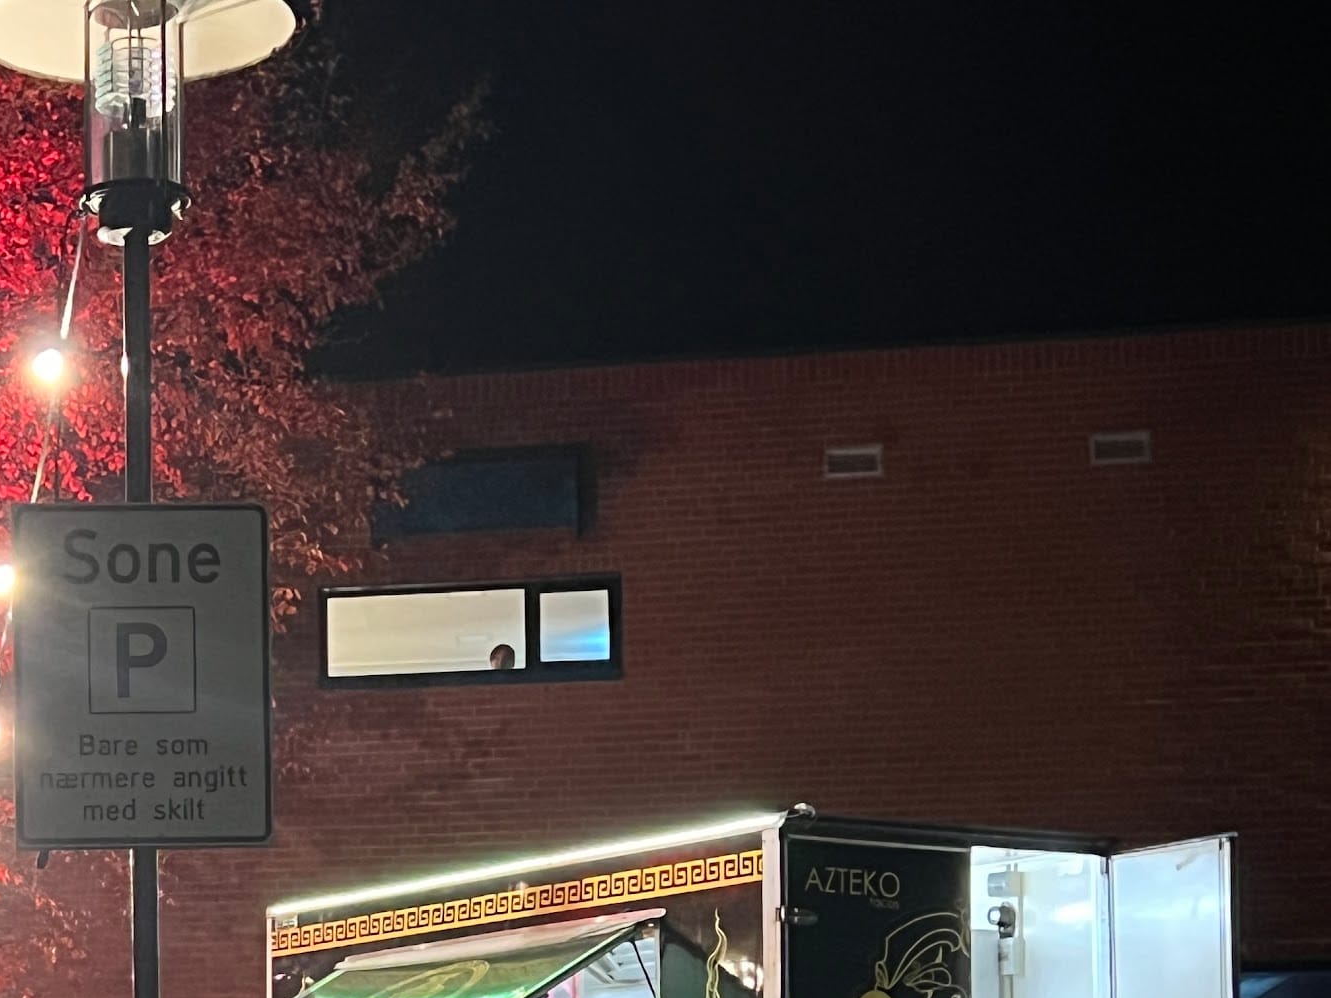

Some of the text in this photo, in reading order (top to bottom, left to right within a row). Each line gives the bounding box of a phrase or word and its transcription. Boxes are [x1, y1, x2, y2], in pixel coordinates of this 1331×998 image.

[62, 528, 221, 585] Sone
[116, 621, 169, 699] P
[78, 733, 209, 756] Bare som
[39, 764, 248, 793] nærmere angitt
[82, 797, 205, 821] med skilt
[804, 867, 901, 899] AZTEKO
